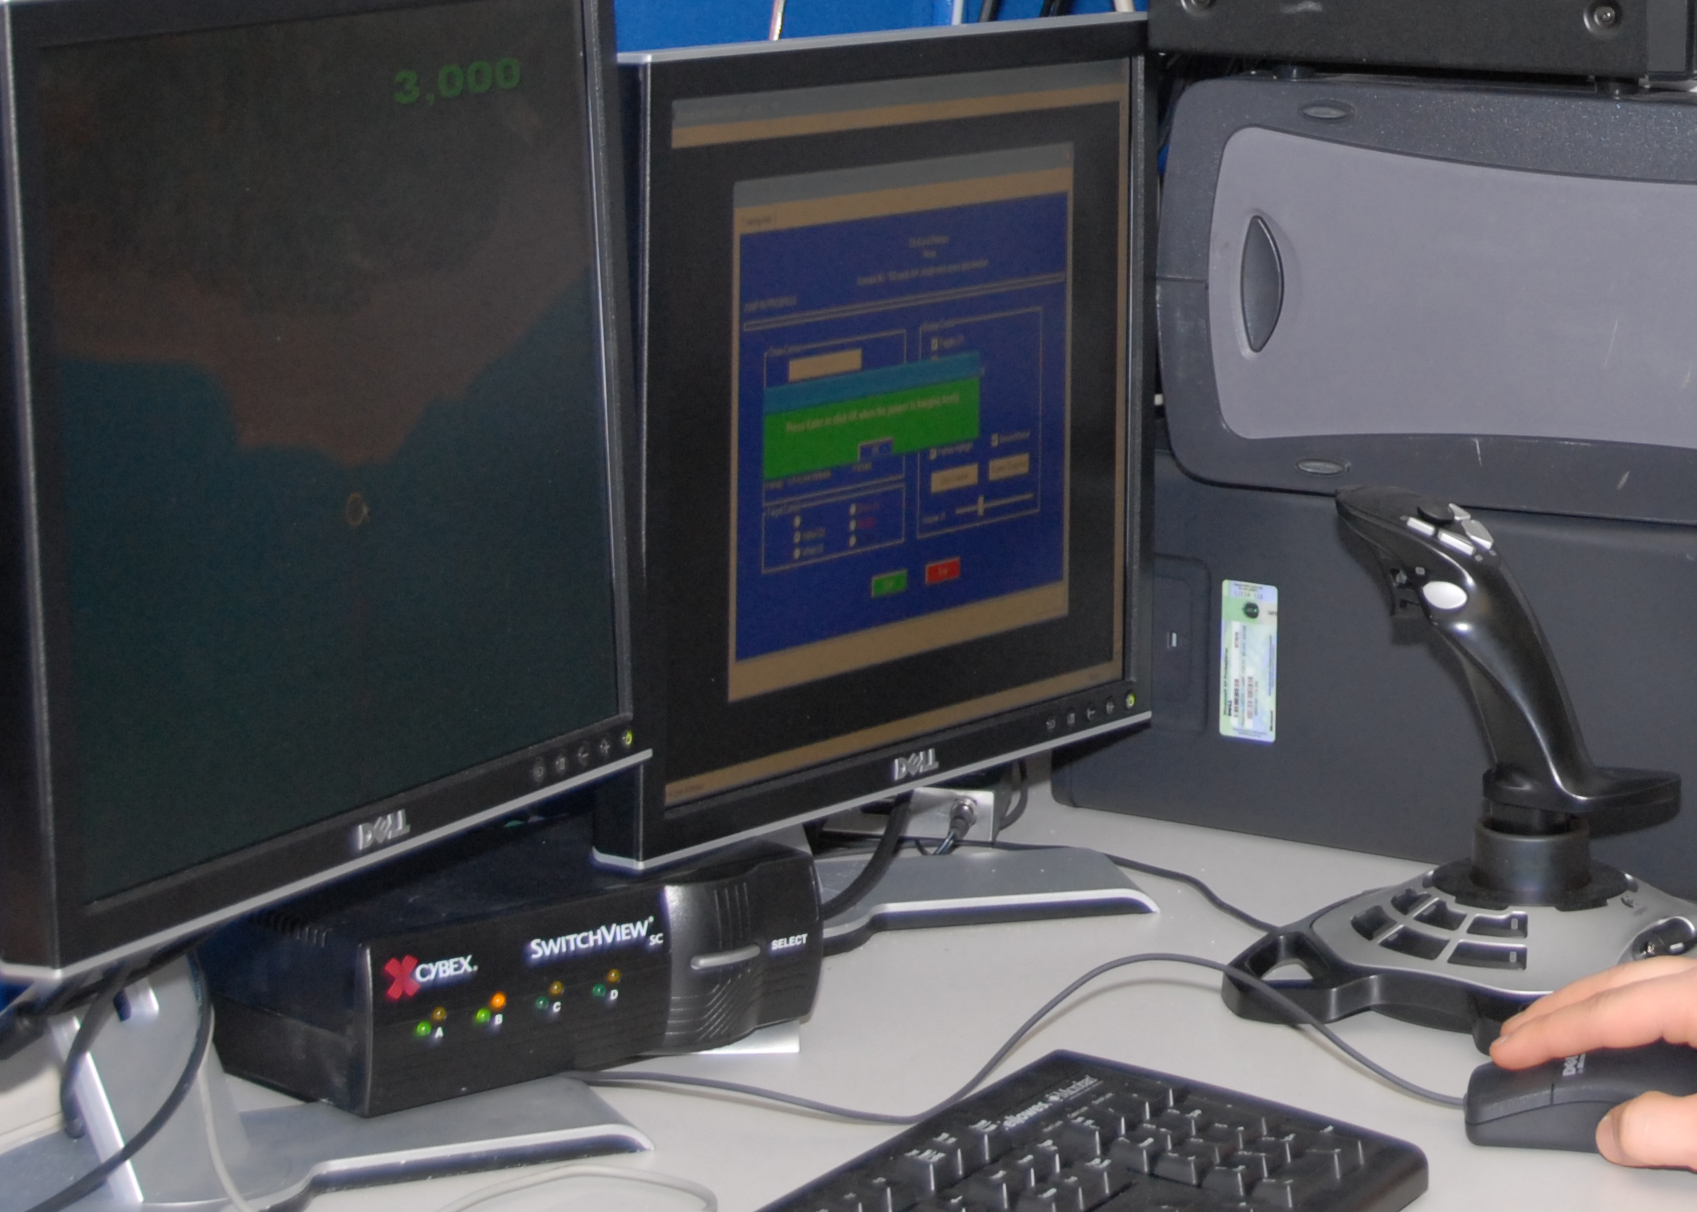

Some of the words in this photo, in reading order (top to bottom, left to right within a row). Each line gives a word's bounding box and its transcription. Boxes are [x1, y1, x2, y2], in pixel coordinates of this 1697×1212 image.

[393, 56, 521, 106] 3,000
[894, 748, 940, 782] DELL
[356, 809, 411, 852] DELL
[771, 932, 808, 952] SELECT
[610, 988, 619, 1000] D
[552, 1001, 562, 1013] C
[494, 1014, 503, 1026] B
[435, 1026, 444, 1038] A
